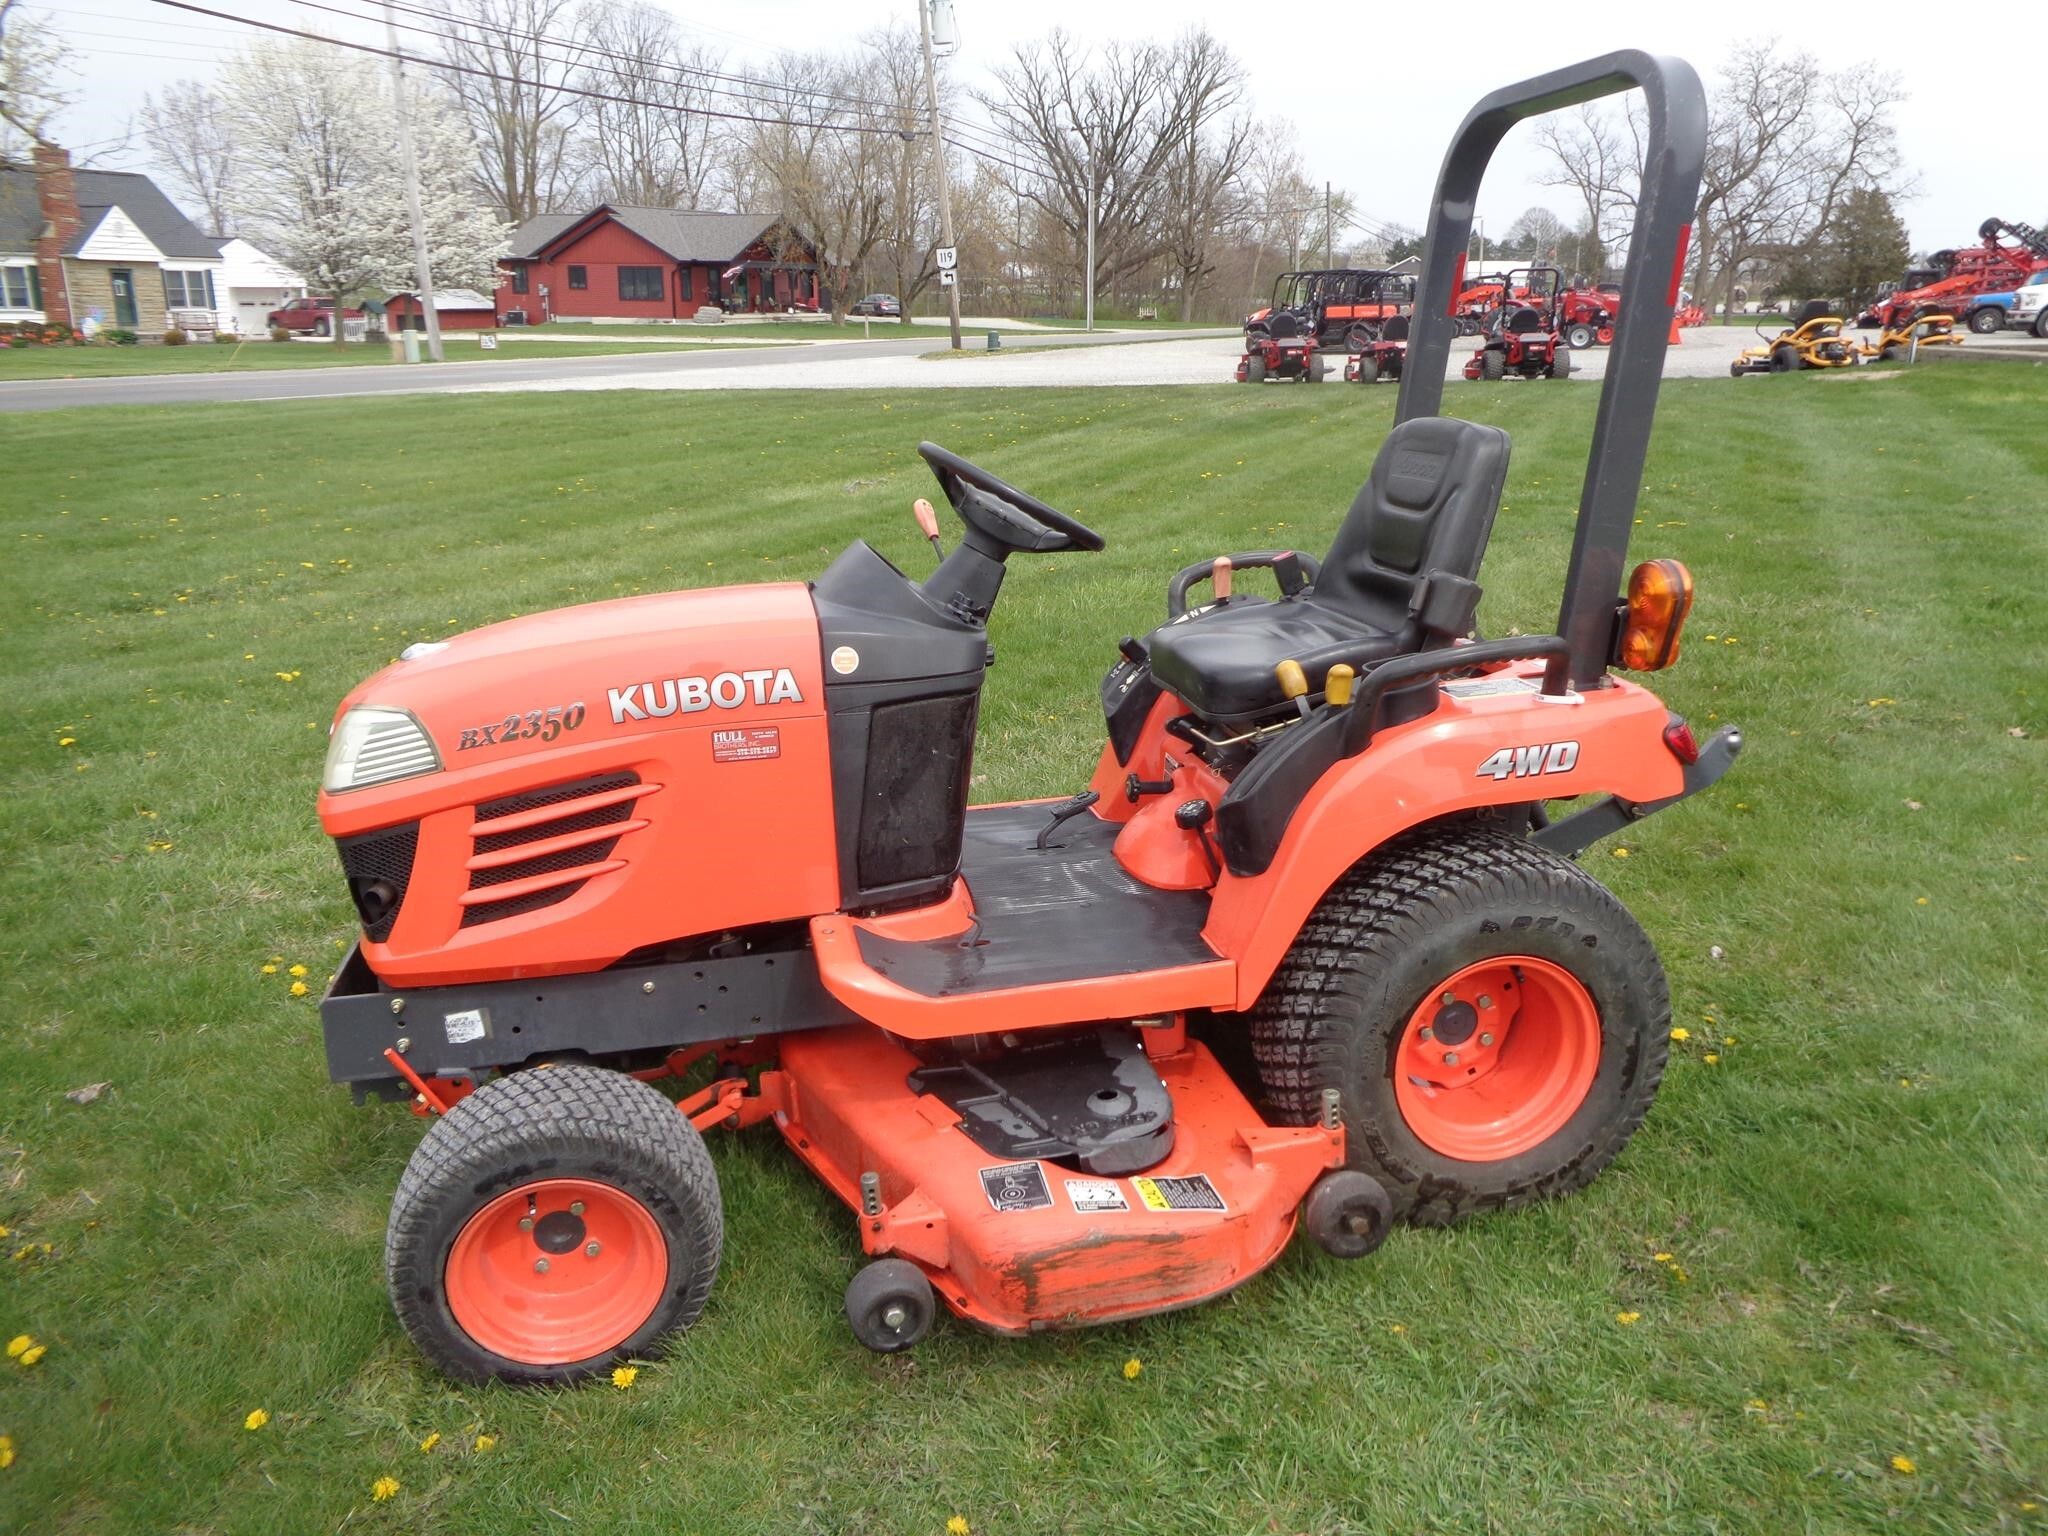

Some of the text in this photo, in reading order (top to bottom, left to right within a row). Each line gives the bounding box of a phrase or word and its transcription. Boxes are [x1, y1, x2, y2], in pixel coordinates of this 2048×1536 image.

[940, 252, 953, 263] 119
[607, 668, 803, 724] KUBOTA
[456, 701, 585, 751] BX2350
[713, 731, 746, 743] HULL
[1475, 741, 1580, 781] 4WD
